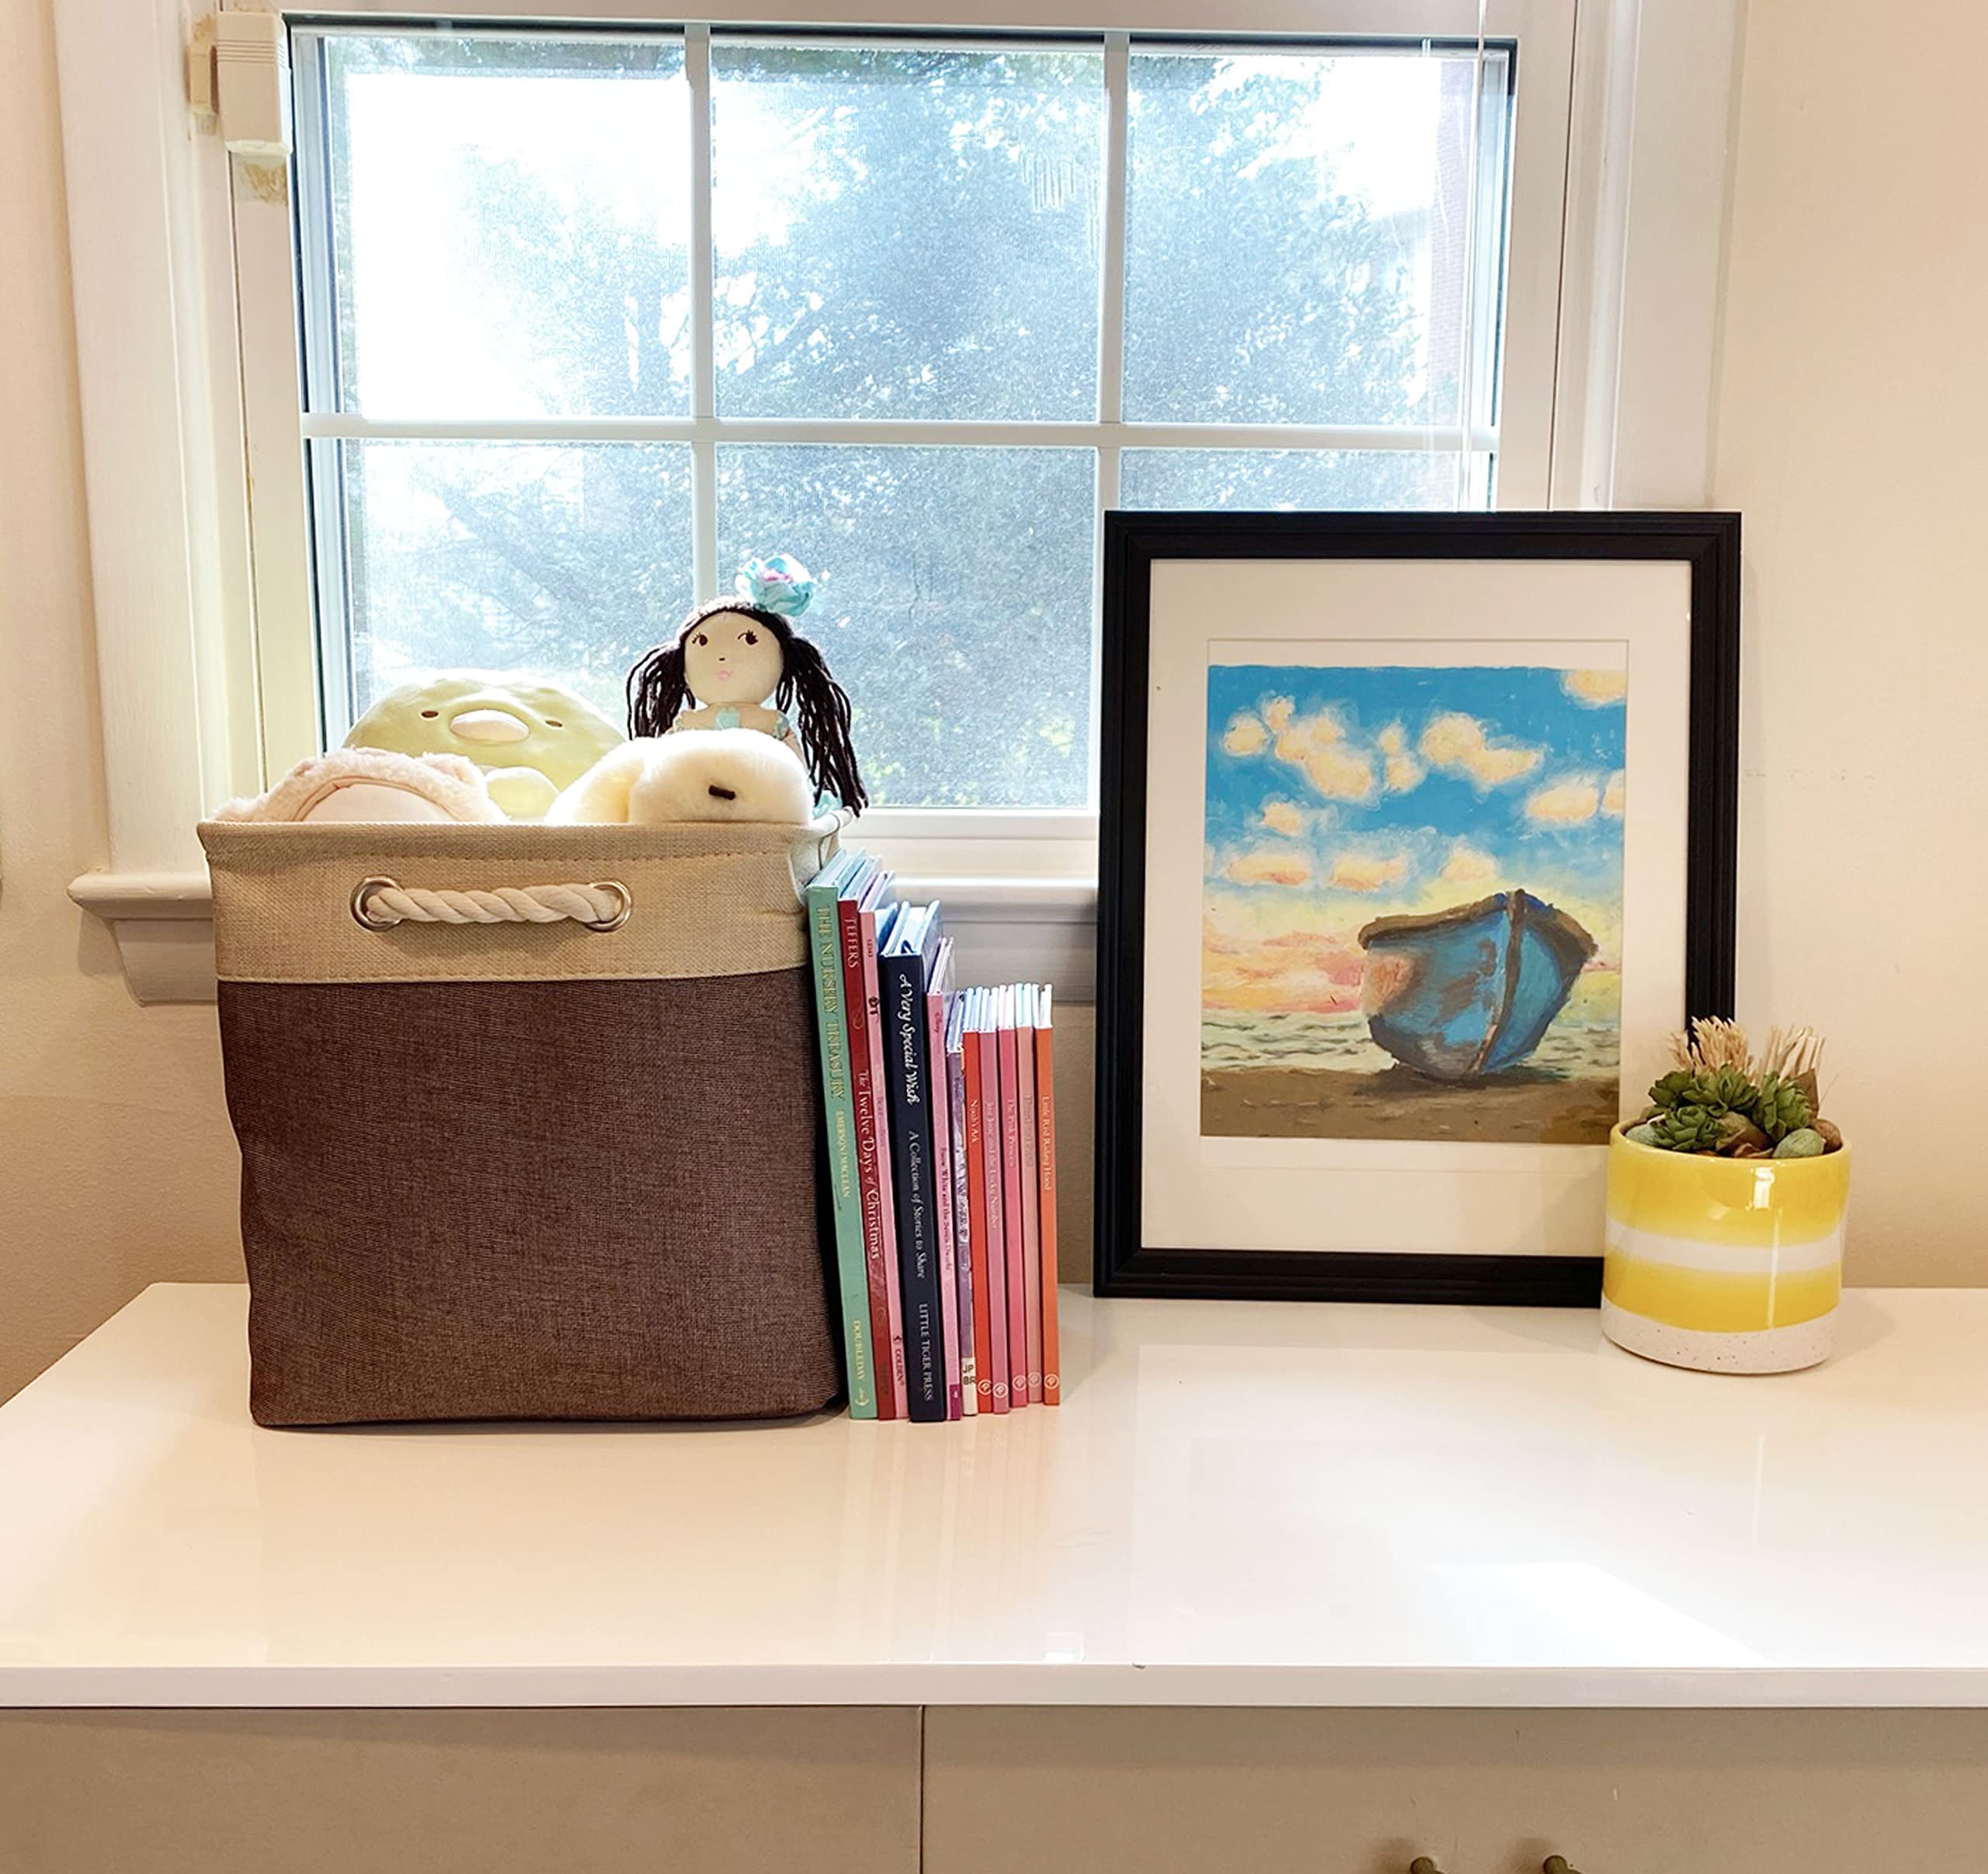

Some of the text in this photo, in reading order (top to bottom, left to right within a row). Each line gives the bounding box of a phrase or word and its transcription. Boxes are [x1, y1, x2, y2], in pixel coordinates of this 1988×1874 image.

[844, 916, 860, 968] JEFFERS
[818, 906, 845, 1100] THE NURSERY TREASURY
[898, 973, 920, 1106] A Very Special Wish
[858, 1069, 870, 1087] The
[859, 1090, 874, 1135] Twelve
[970, 1099, 978, 1127] Noah's
[859, 1136, 876, 1173] Days
[1044, 1167, 1052, 1191] Hood
[866, 1188, 881, 1260] Christmas
[909, 1131, 927, 1279] A Collection of Stories to Share
[943, 1208, 951, 1220] the
[853, 1320, 866, 1380] DOUBLEDAY
[919, 1303, 934, 1401] LITTLE TIGER PRESS
[962, 1365, 974, 1373] JP
